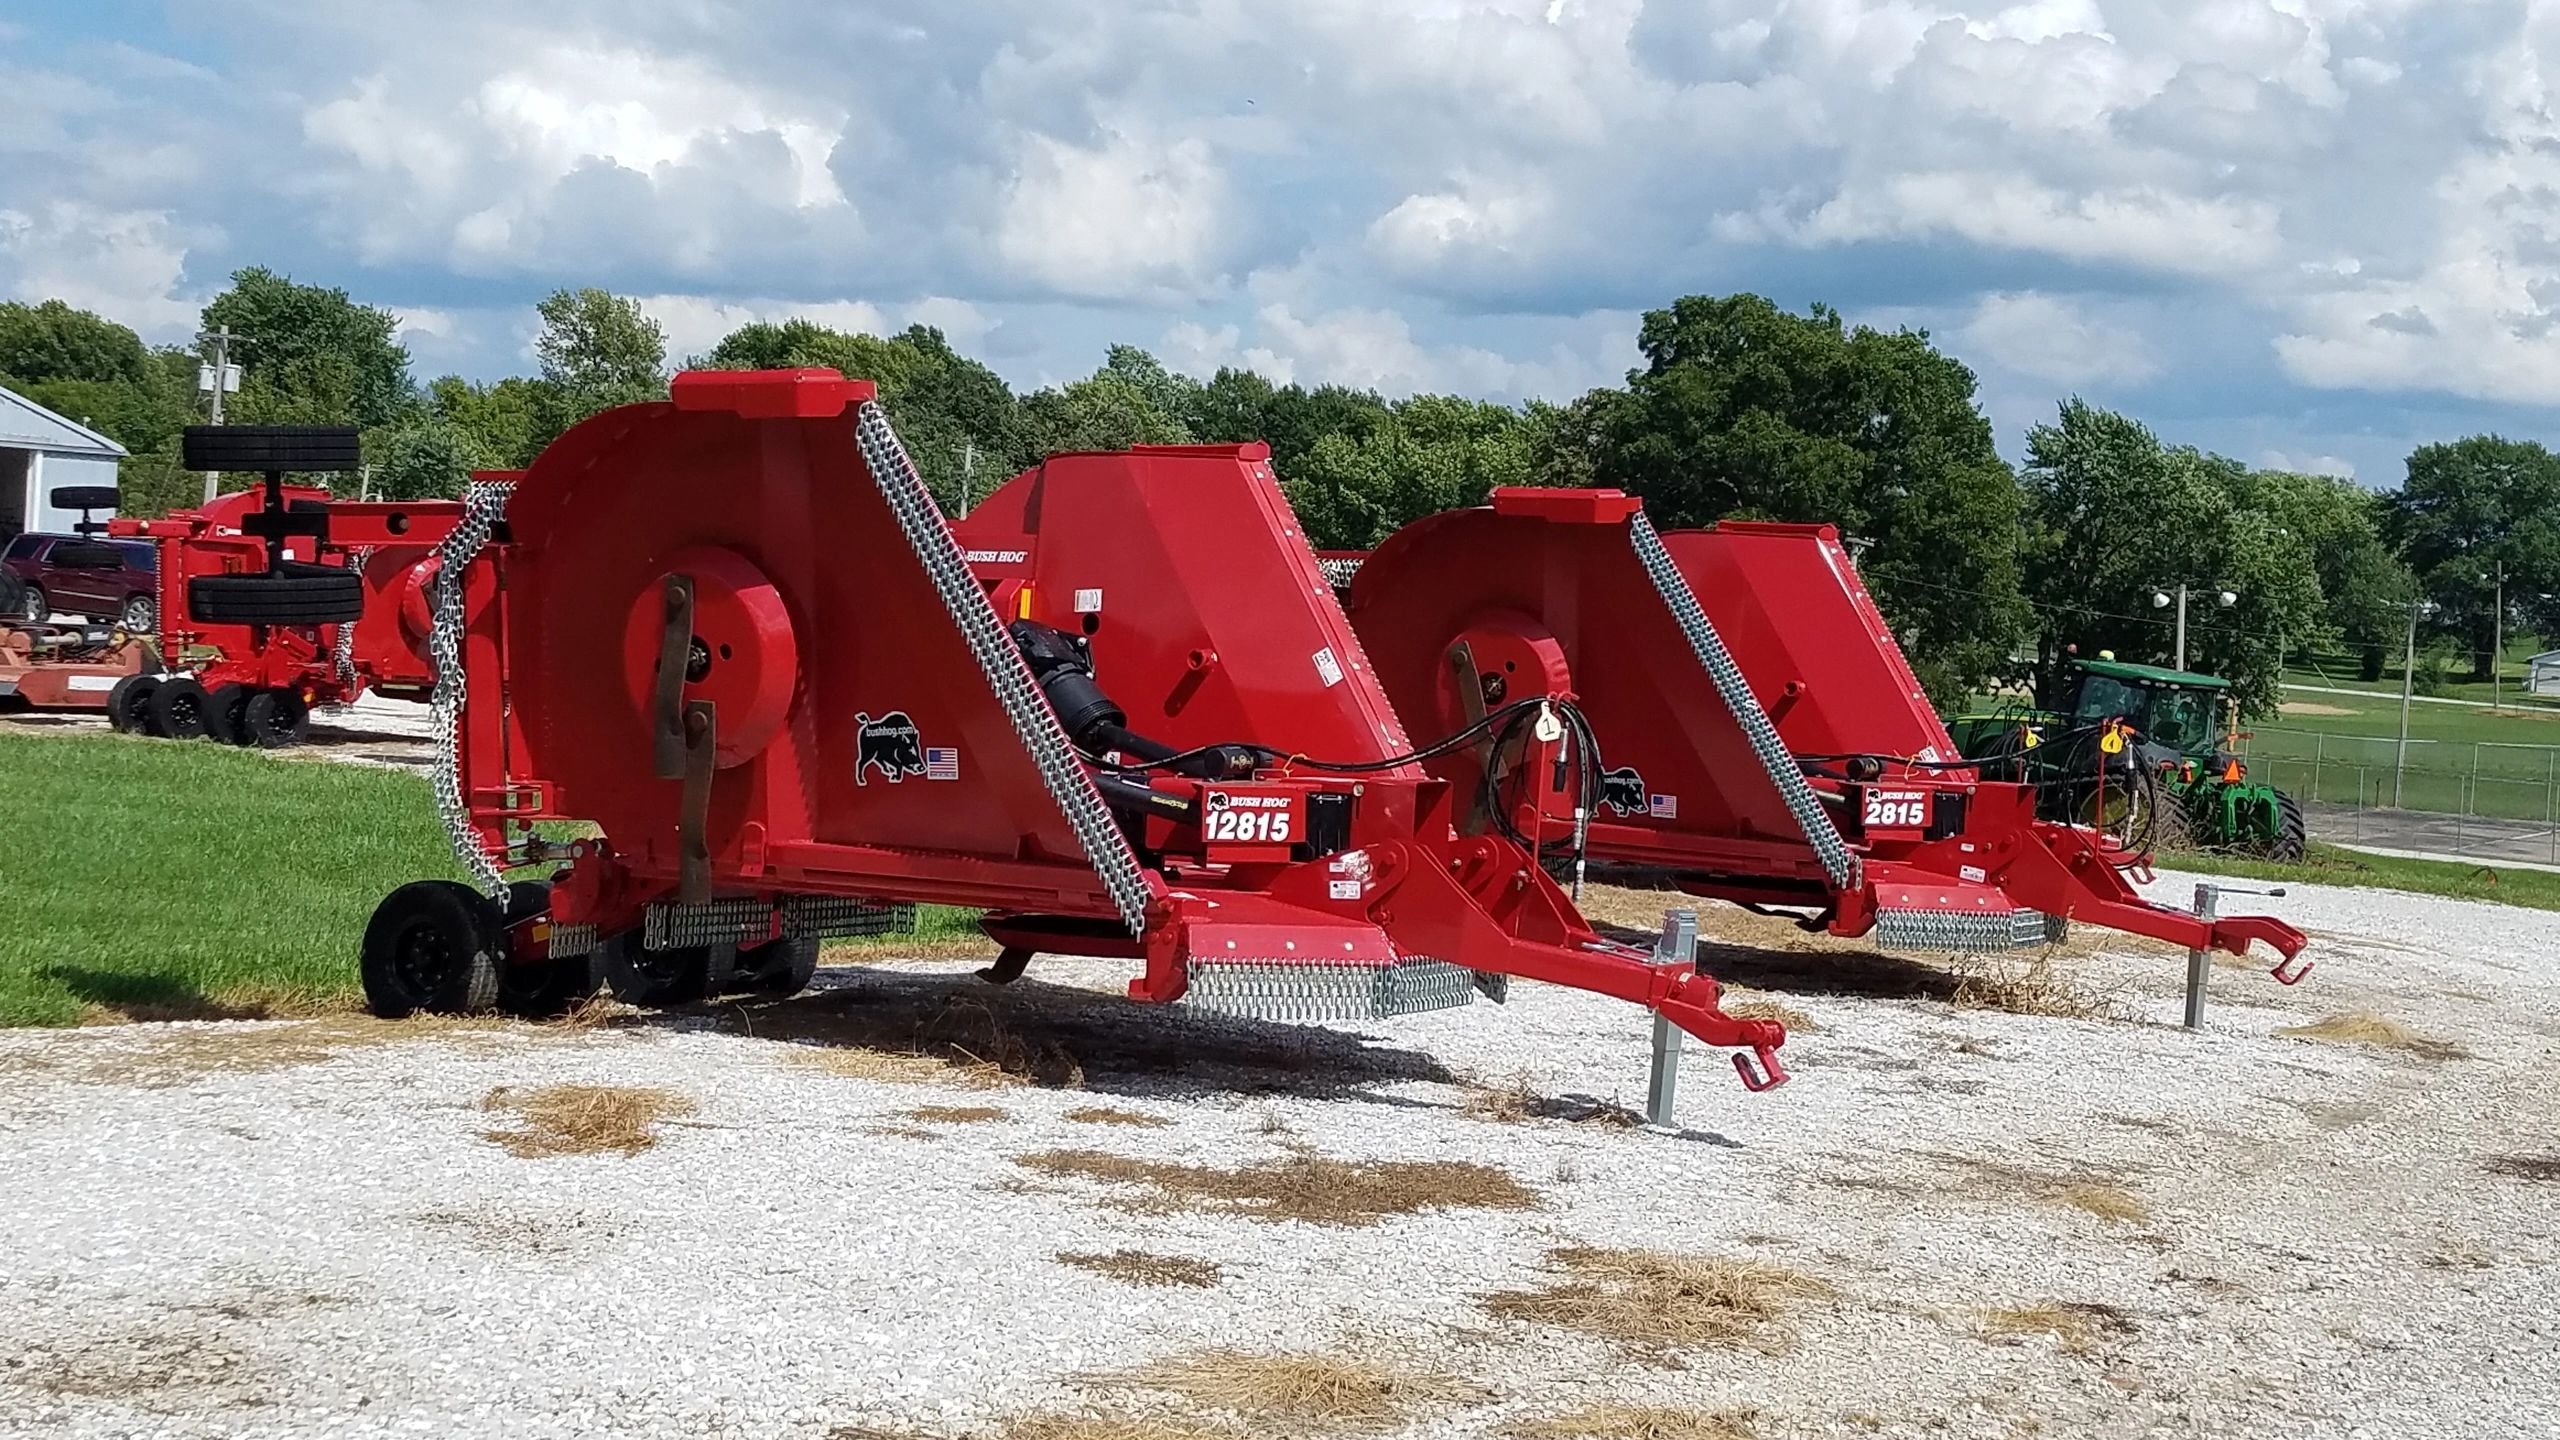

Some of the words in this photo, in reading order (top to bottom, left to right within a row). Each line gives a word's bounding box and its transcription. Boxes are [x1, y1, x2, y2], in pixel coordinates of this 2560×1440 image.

[966, 550, 998, 562] BUSH
[998, 551, 1025, 562] HOG
[866, 726, 914, 738] bushhog.com
[1543, 717, 1555, 735] 1
[1230, 797, 1261, 807] BUSH
[1261, 797, 1289, 807] HOG
[1865, 802, 1924, 825] 2815
[1206, 811, 1289, 842] 12815
